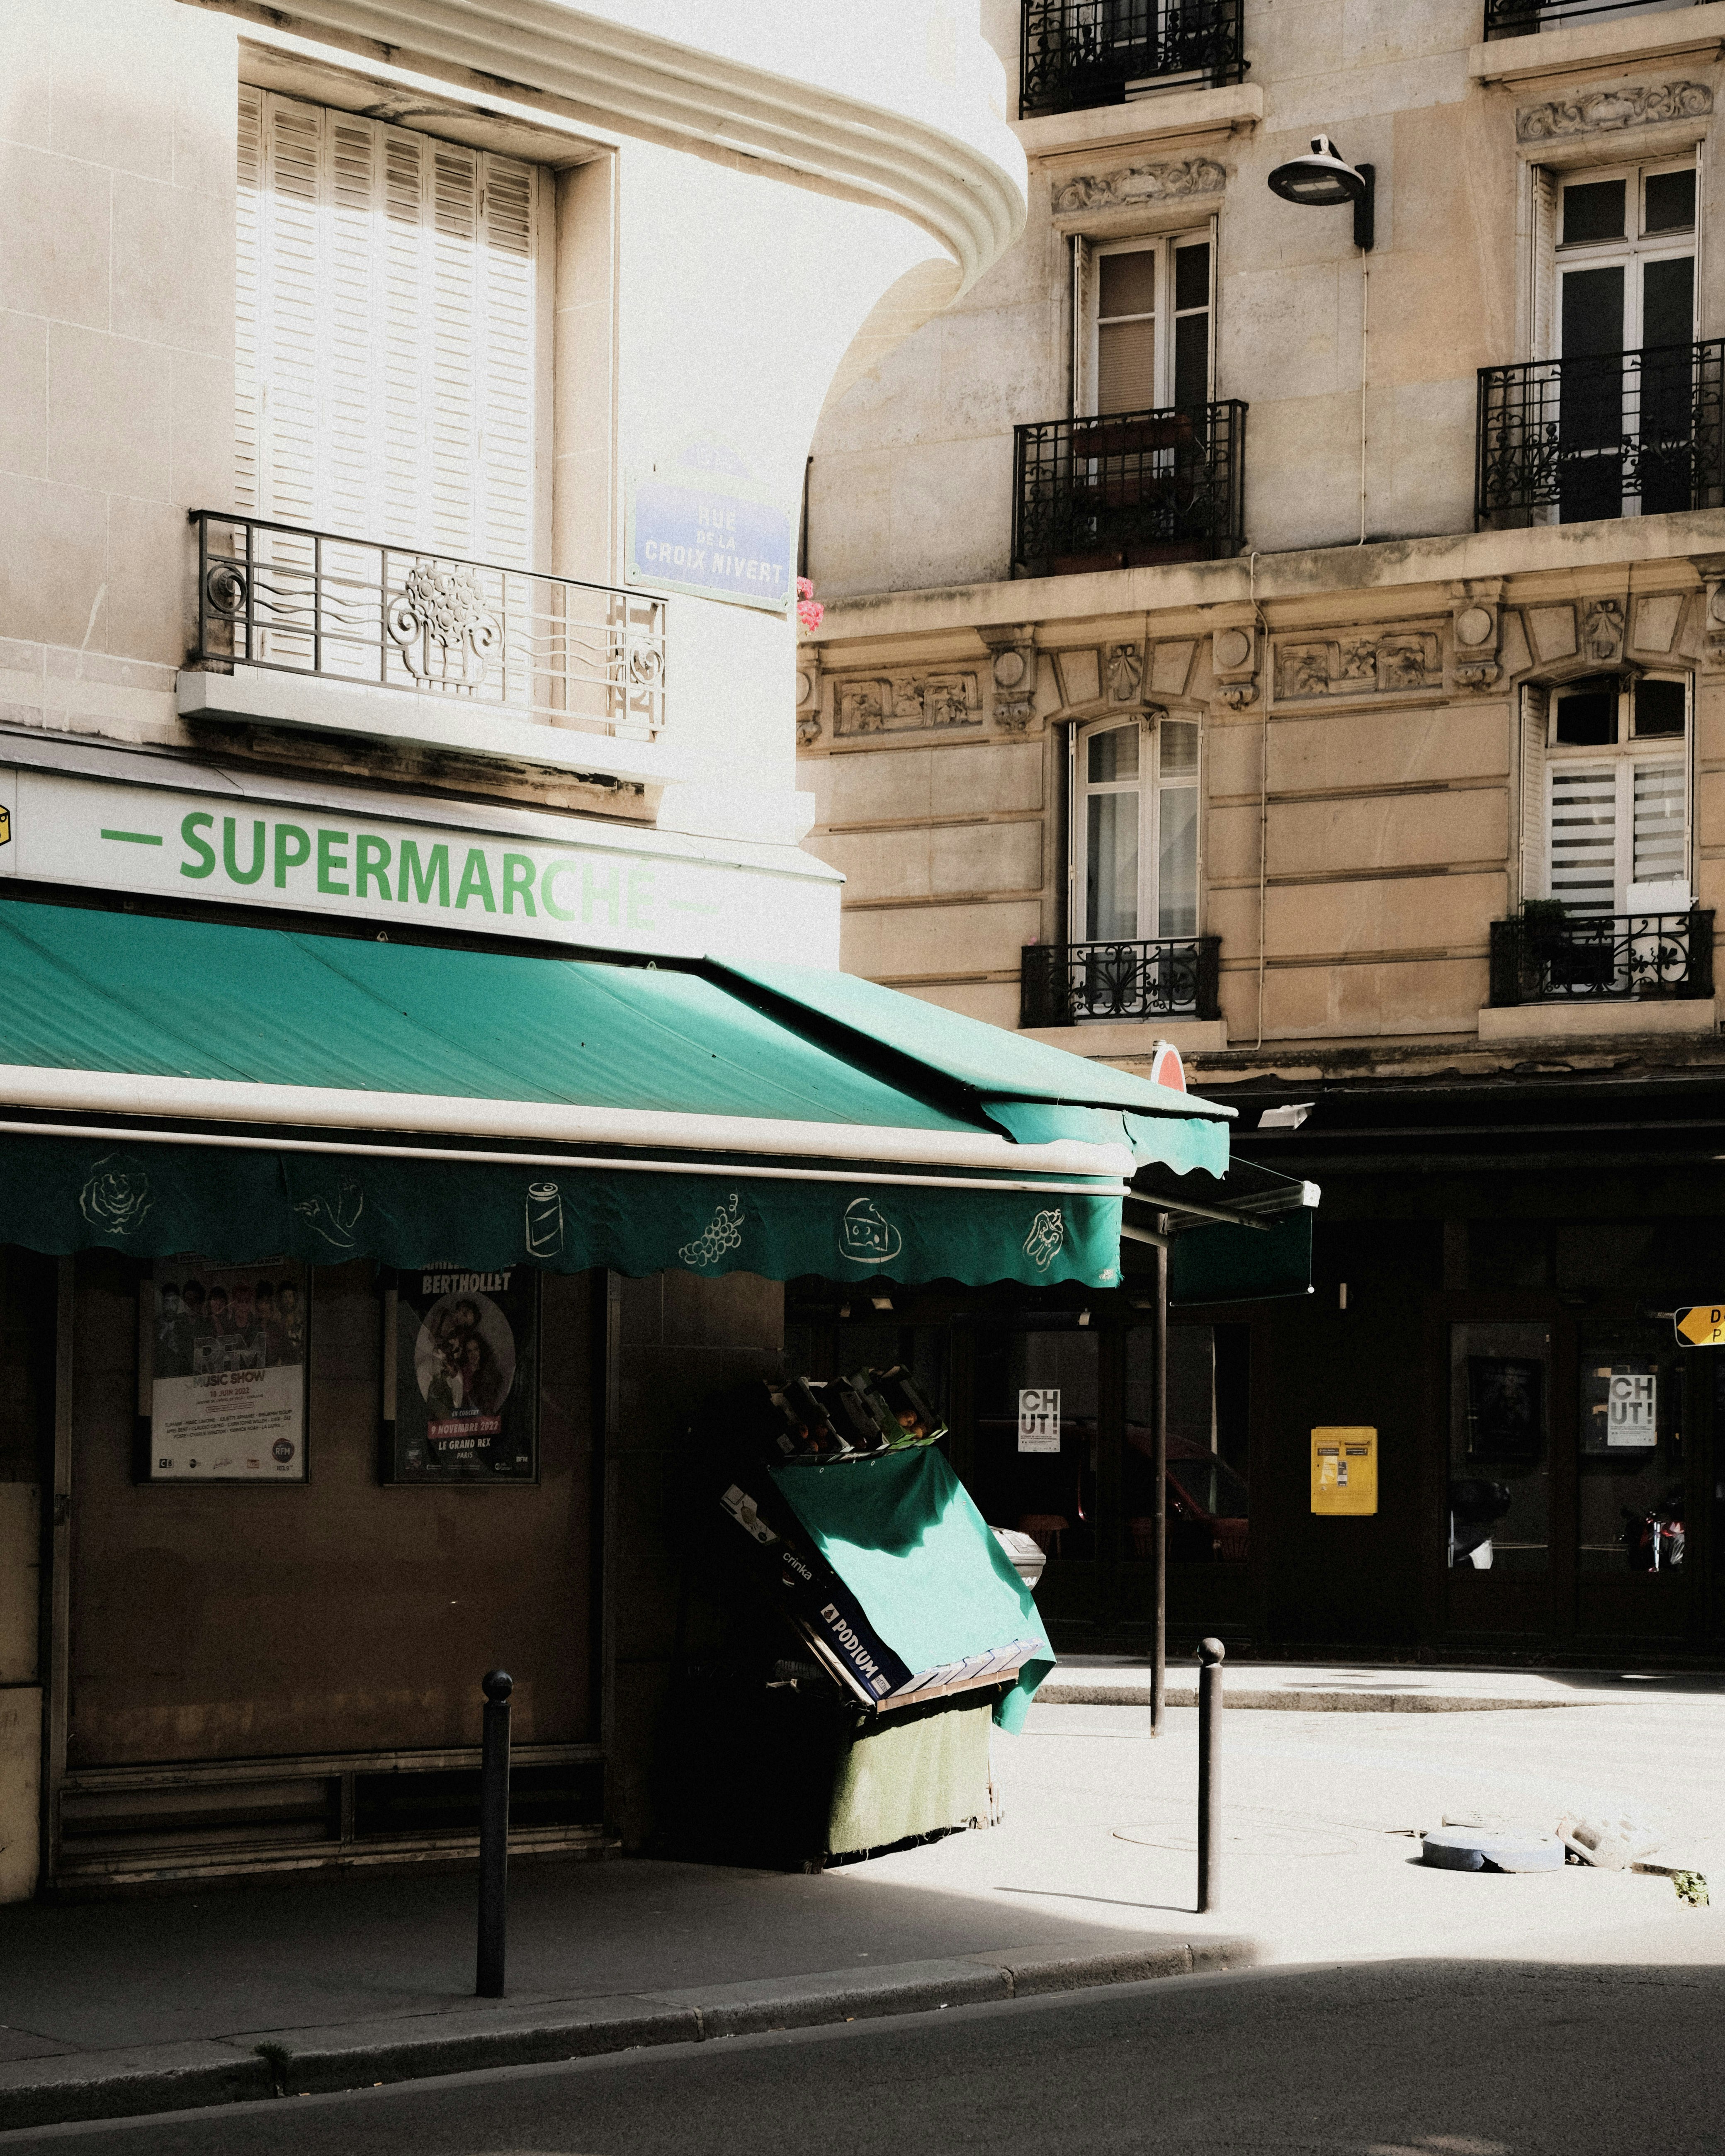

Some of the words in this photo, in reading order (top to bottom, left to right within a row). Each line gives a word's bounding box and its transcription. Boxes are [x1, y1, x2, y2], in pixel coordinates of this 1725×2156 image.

[698, 505, 736, 532] RUE
[697, 530, 714, 546] DE
[719, 535, 736, 551] LA
[645, 540, 705, 570] CROIX
[712, 553, 783, 584] NIVERT
[180, 811, 656, 931] SUPERMARCHÉ
[422, 1272, 511, 1294] BERTHOLLET
[194, 1332, 267, 1374] RFM
[193, 1372, 228, 1388] MUSIC
[231, 1369, 265, 1384] SHOW
[1611, 1377, 1652, 1400] CH
[1022, 1390, 1058, 1411] CH
[1021, 1413, 1057, 1434] UT!
[1611, 1402, 1652, 1425] UT!
[431, 1425, 436, 1435] 9
[438, 1422, 478, 1434] NOVEMBRE
[480, 1420, 498, 1431] 2022
[275, 1446, 290, 1456] RFM
[438, 1441, 447, 1450] LE
[449, 1439, 474, 1449] GRAND
[477, 1438, 491, 1447] REX
[783, 1551, 812, 1581] crinka
[831, 1618, 879, 1679] PODIUM
